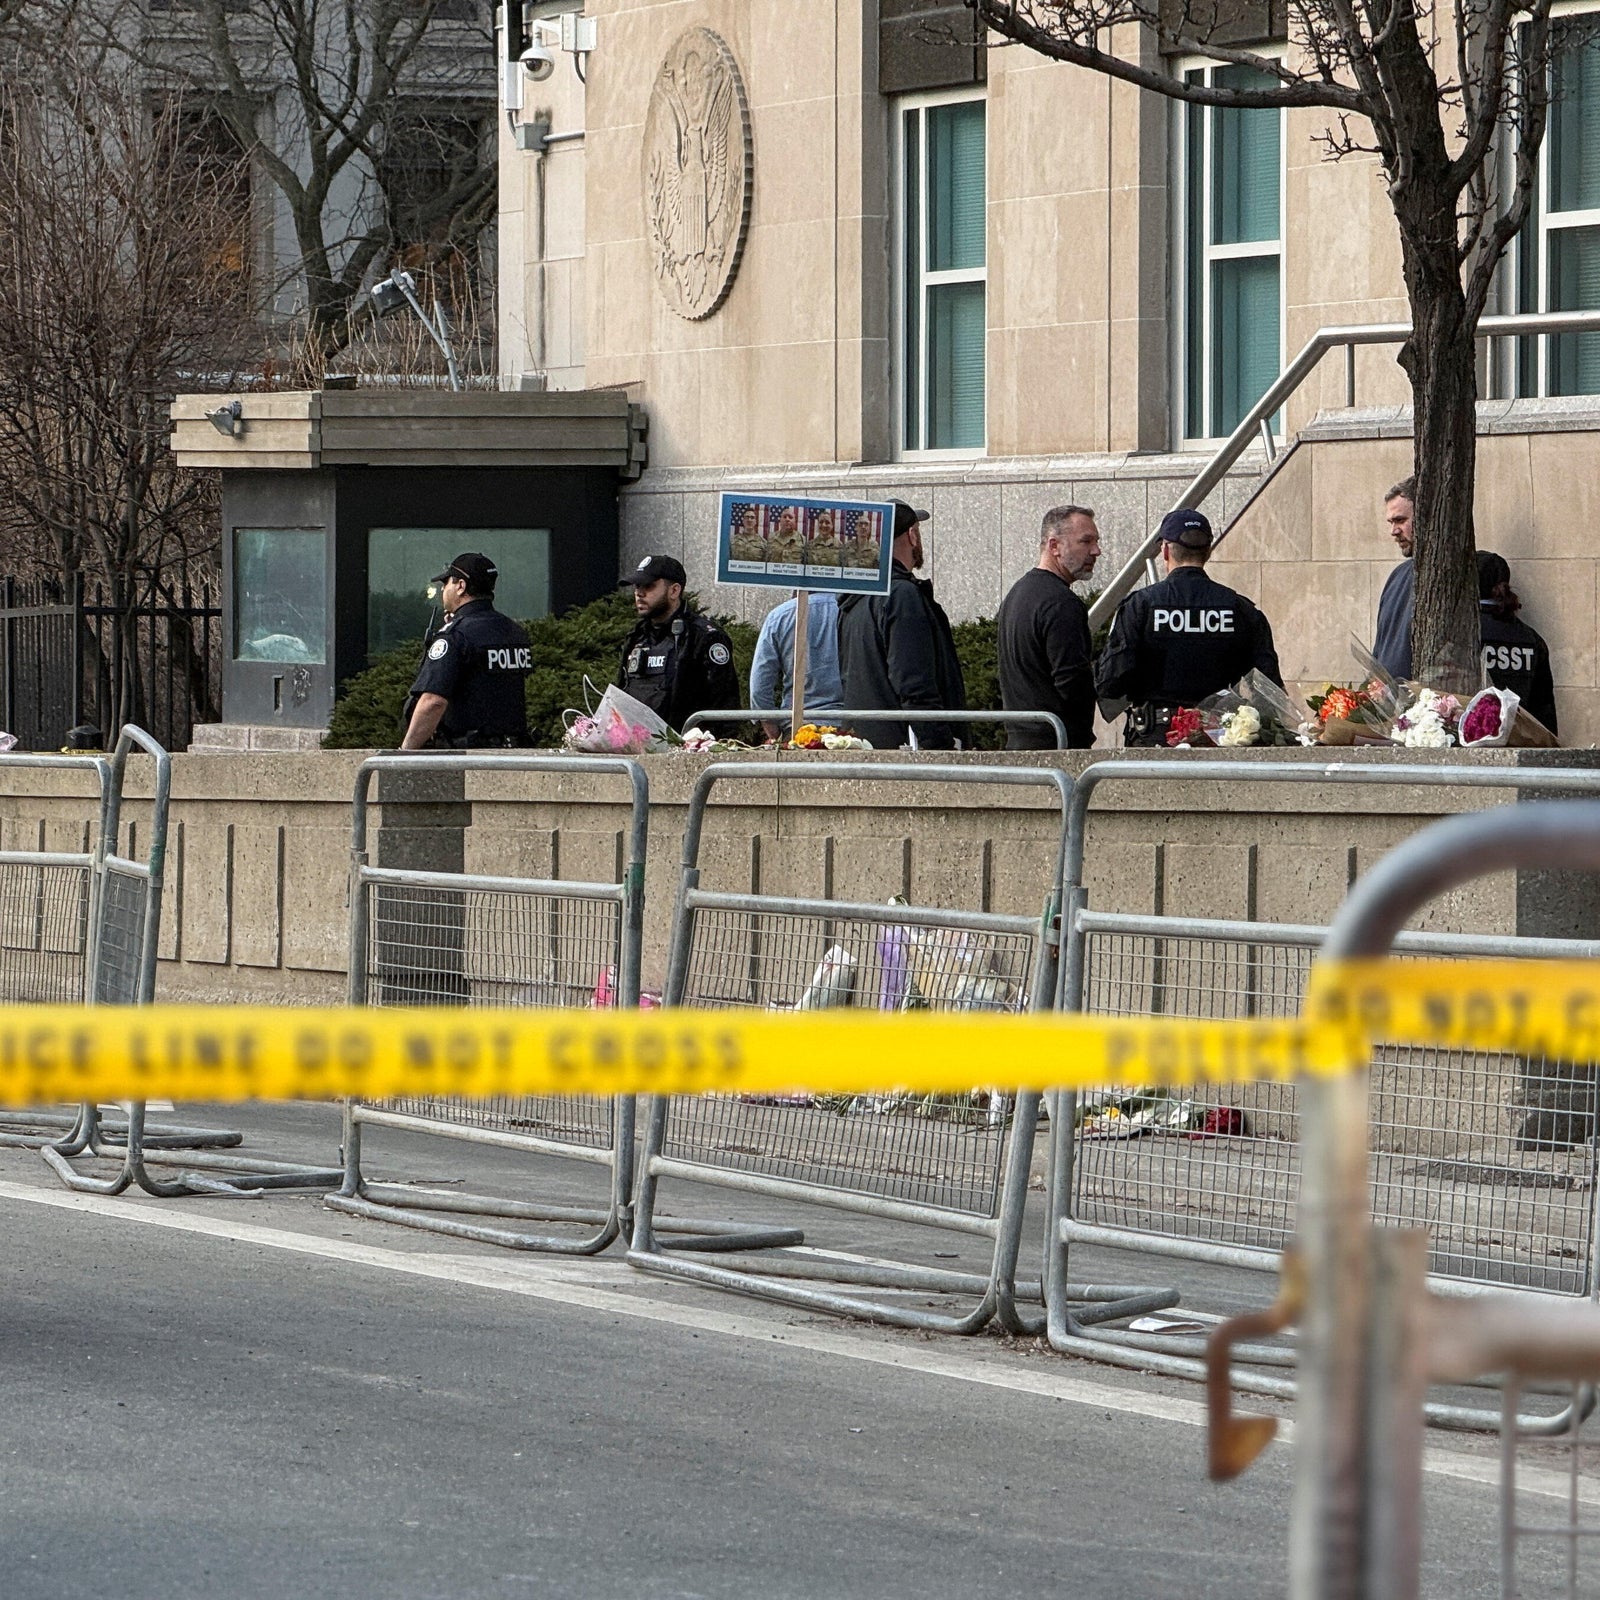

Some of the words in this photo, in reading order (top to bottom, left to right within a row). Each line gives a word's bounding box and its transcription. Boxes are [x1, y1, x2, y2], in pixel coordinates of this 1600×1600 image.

[1153, 609, 1235, 633] POLICE
[487, 648, 532, 670] POLICE
[647, 655, 666, 668] POLICE
[1482, 645, 1535, 671] CSST
[129, 1025, 259, 1077] LINE
[293, 1025, 375, 1073] DO
[405, 1025, 514, 1072] NOT
[548, 1025, 744, 1074] CROSS
